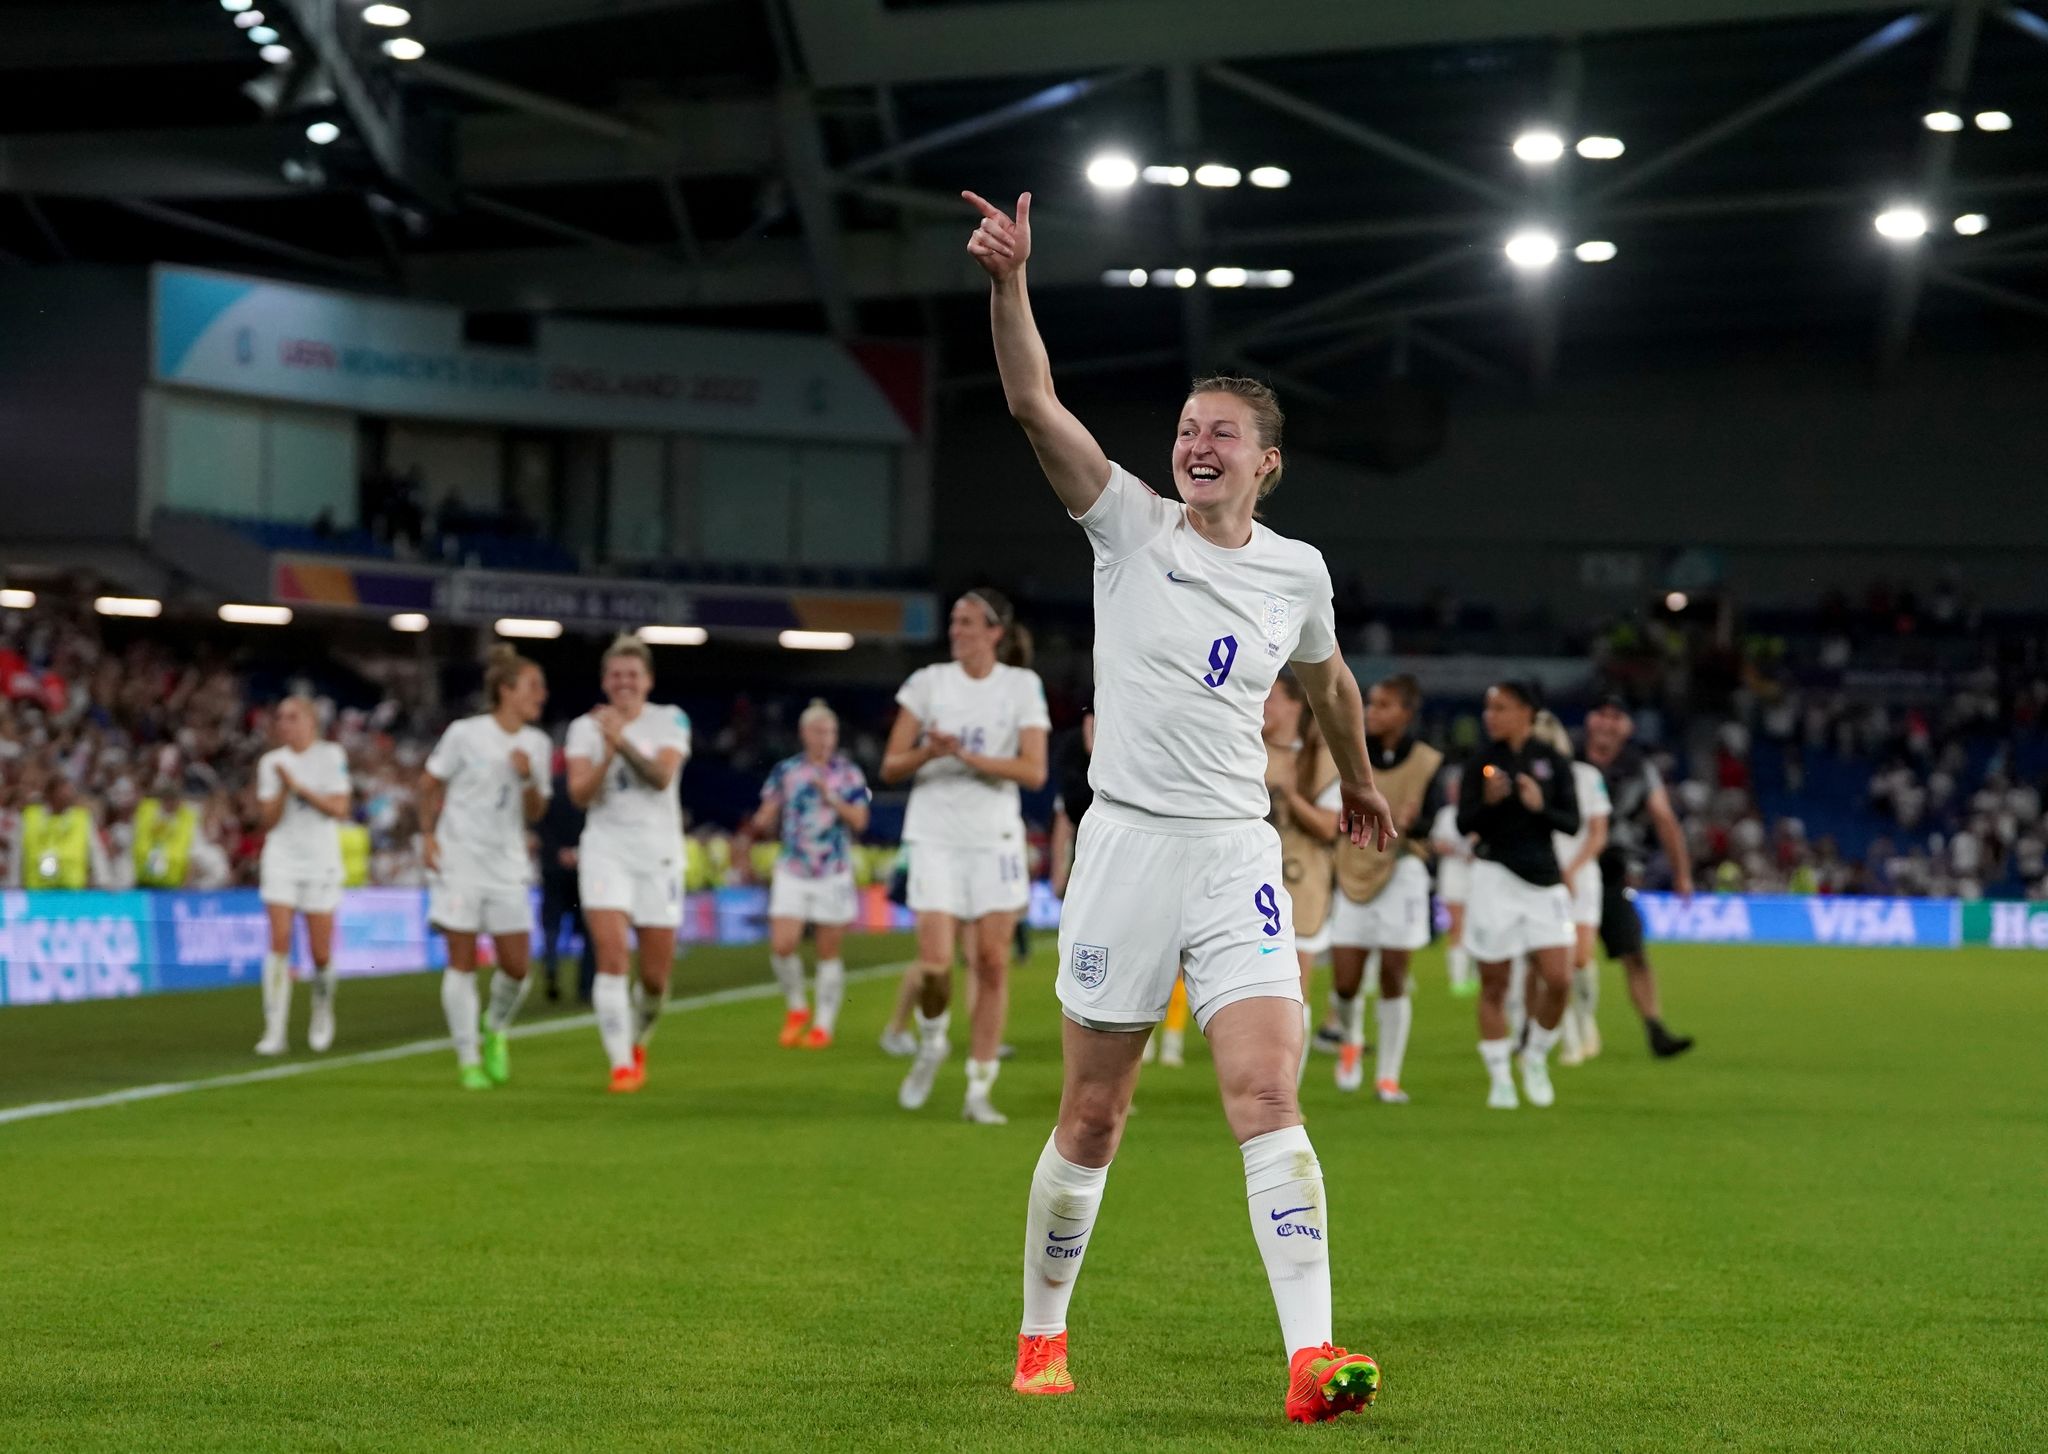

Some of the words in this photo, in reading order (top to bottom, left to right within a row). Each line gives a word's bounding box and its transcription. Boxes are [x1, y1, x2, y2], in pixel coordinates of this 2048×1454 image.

[1203, 634, 1238, 688] 9
[1255, 883, 1281, 936] 9
[1644, 897, 1750, 940] VISA
[1808, 898, 1916, 944] VISA
